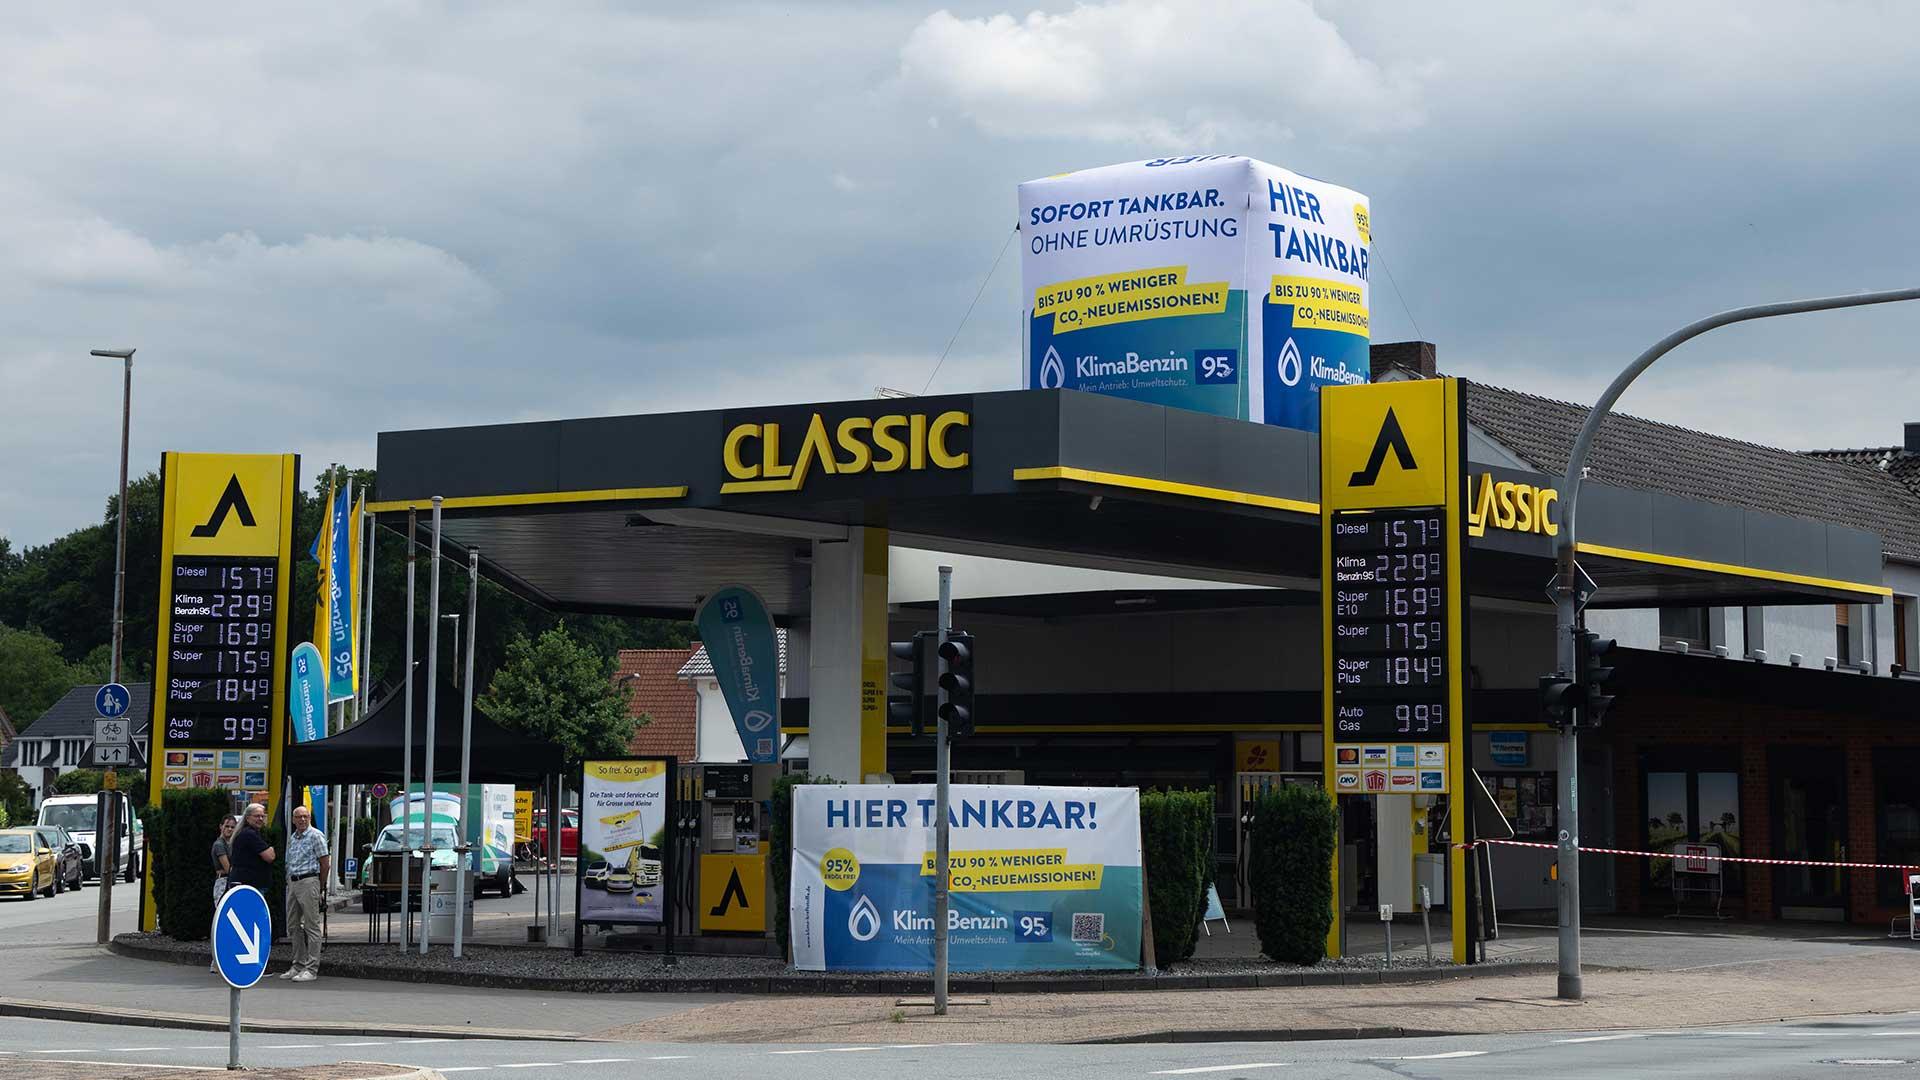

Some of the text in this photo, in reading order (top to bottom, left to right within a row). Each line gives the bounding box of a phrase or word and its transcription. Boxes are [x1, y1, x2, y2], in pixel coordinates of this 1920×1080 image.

[1031, 188, 1225, 226] SOFORT TANKBAR.
[1267, 178, 1325, 225] HIER
[1031, 217, 1238, 255] OHNE UMRÜSTUNG
[1038, 273, 1178, 309] BIS ZU 90 % WENIGER
[1275, 284, 1360, 305] BIS ZU 90 % WENIGER
[1076, 350, 1231, 379] KlimaBenzin 95
[1131, 377, 1189, 389] Umweltschutz.
[720, 411, 969, 493] CLASSIC
[1467, 472, 1558, 537] LASSIC
[1336, 523, 1369, 534] Diesel
[1336, 556, 1366, 568] Klima
[176, 566, 207, 577] Diesel
[175, 594, 203, 604] Klima
[1337, 591, 1369, 604] Super
[1337, 604, 1358, 615] E10
[174, 622, 204, 633] Super
[1337, 624, 1369, 638] Super
[173, 633, 193, 643] E10
[172, 651, 202, 661] Super
[334, 651, 353, 678] 95
[1337, 658, 1370, 672] Super
[171, 678, 201, 689] Super
[1337, 672, 1361, 684] Plus
[170, 689, 193, 700] Plus
[1338, 706, 1364, 717] Auto
[169, 717, 193, 728] Auto
[1338, 719, 1361, 731] Gas
[168, 728, 190, 739] Gas
[598, 765, 607, 774] So
[623, 765, 632, 774] So
[742, 774, 749, 783] 8
[1340, 776, 1357, 784] DKV
[827, 799, 908, 829] HIER
[347, 860, 356, 871] P
[826, 859, 854, 873] 95%
[950, 855, 1063, 868] ZU 90 % WENIGER
[893, 909, 1047, 937] KlimBenzin 95
[893, 935, 914, 945] Mein
[949, 935, 1009, 945] Umweltschutz.
